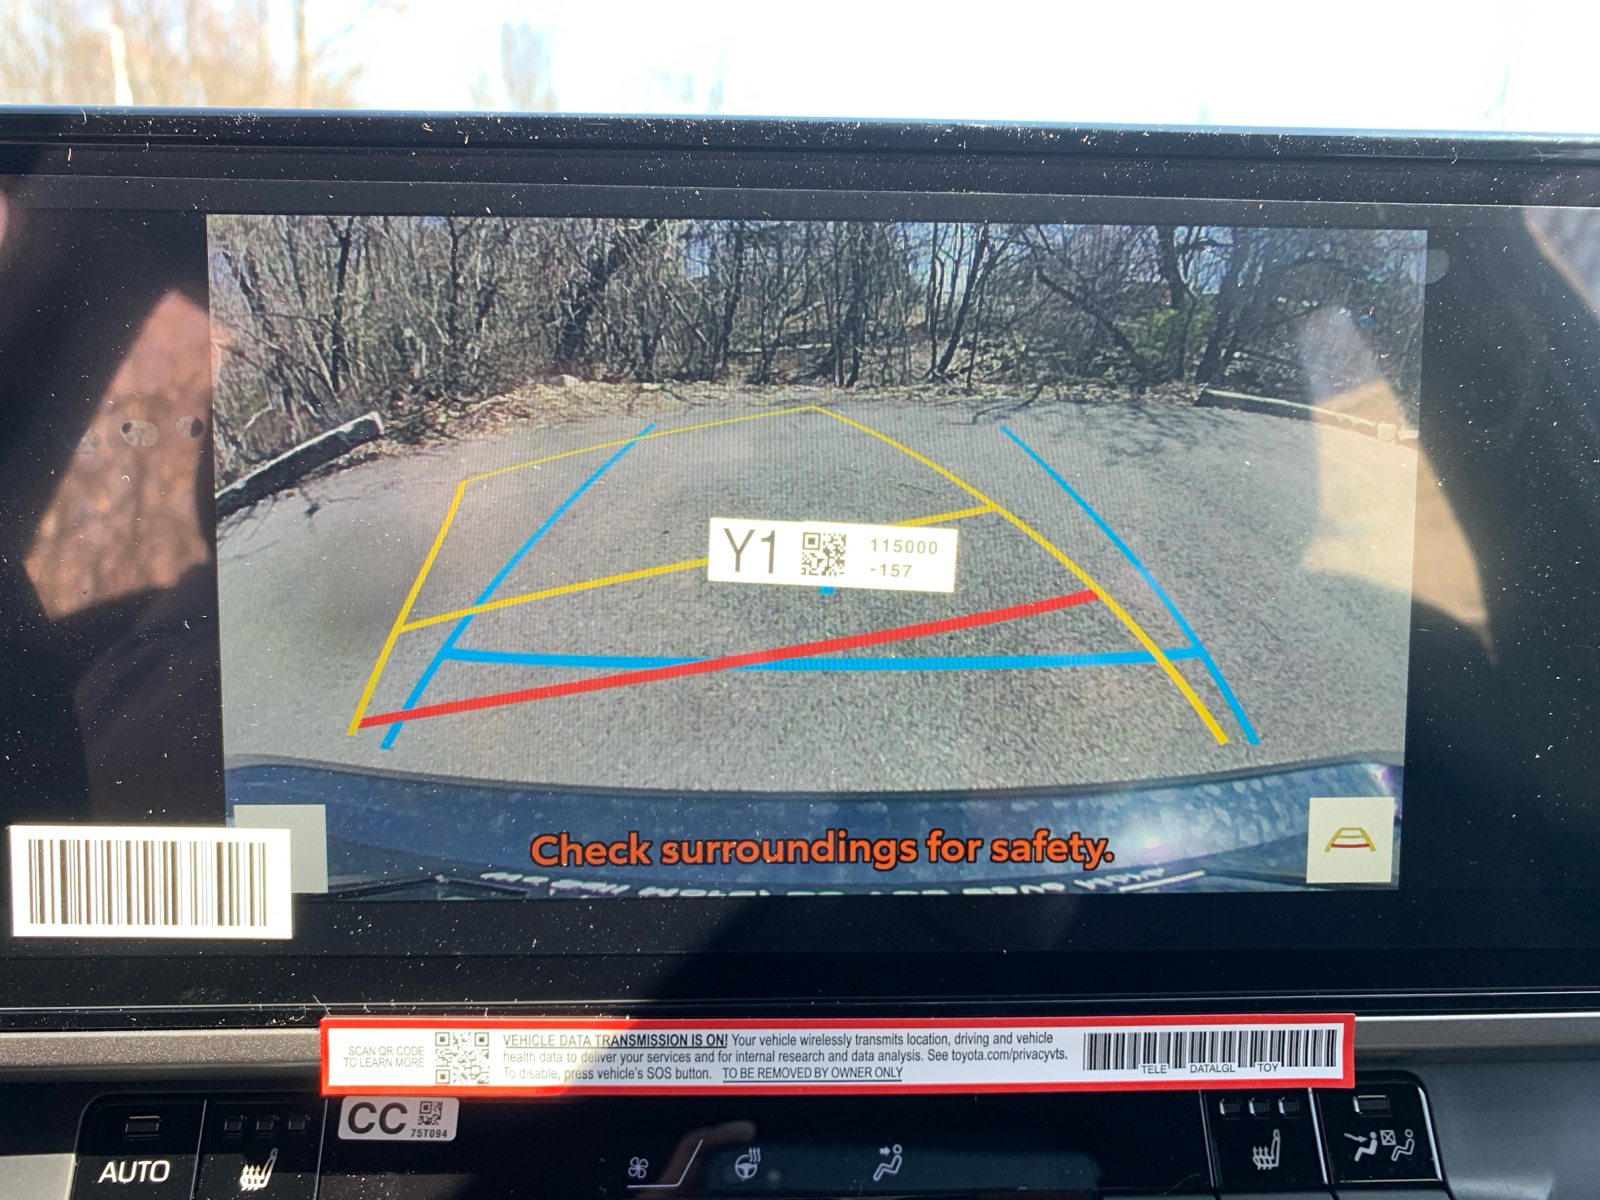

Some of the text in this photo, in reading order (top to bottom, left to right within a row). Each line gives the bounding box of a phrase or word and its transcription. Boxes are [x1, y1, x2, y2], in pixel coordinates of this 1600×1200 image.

[724, 528, 776, 574] Y1
[870, 538, 938, 555] 115000
[870, 564, 912, 578] -157
[531, 829, 1114, 871] Check surroundings for safety.
[503, 1032, 1053, 1048] VEHICLE DATA TRANSMISSION IS ON! Your vehicle wirelessly transmits location, driving and vehicle
[349, 1046, 424, 1056] SCAN QR CODE
[503, 1051, 535, 1062] health
[539, 1051, 563, 1062] data
[567, 1051, 577, 1062] to
[581, 1051, 616, 1062] deliver
[620, 1053, 644, 1065] your
[647, 1051, 691, 1062] services
[694, 1051, 714, 1062] and
[718, 1051, 732, 1062] for
[736, 1050, 774, 1062] internal
[778, 1050, 824, 1062] research
[828, 1050, 848, 1062] and
[851, 1050, 874, 1062] data
[878, 1050, 924, 1063] analysis.
[928, 1049, 948, 1061] See
[344, 1058, 424, 1067] TO LEARN MORE
[1141, 1062, 1279, 1074] TELE DATALGL TOY
[504, 1067, 515, 1079] To
[519, 1067, 561, 1081] disable,
[564, 1069, 593, 1082] press
[647, 1067, 672, 1079] SOS
[675, 1067, 712, 1079] button.
[723, 1067, 737, 1079] TO
[740, 1067, 754, 1079] BE
[758, 1067, 812, 1078] REMOVED
[815, 1067, 829, 1078] BY
[831, 1067, 872, 1078] OWNER
[875, 1067, 903, 1078] ONLY
[347, 1102, 407, 1134] CC
[411, 1128, 448, 1139] 75T094
[98, 1160, 170, 1184] AUTO
